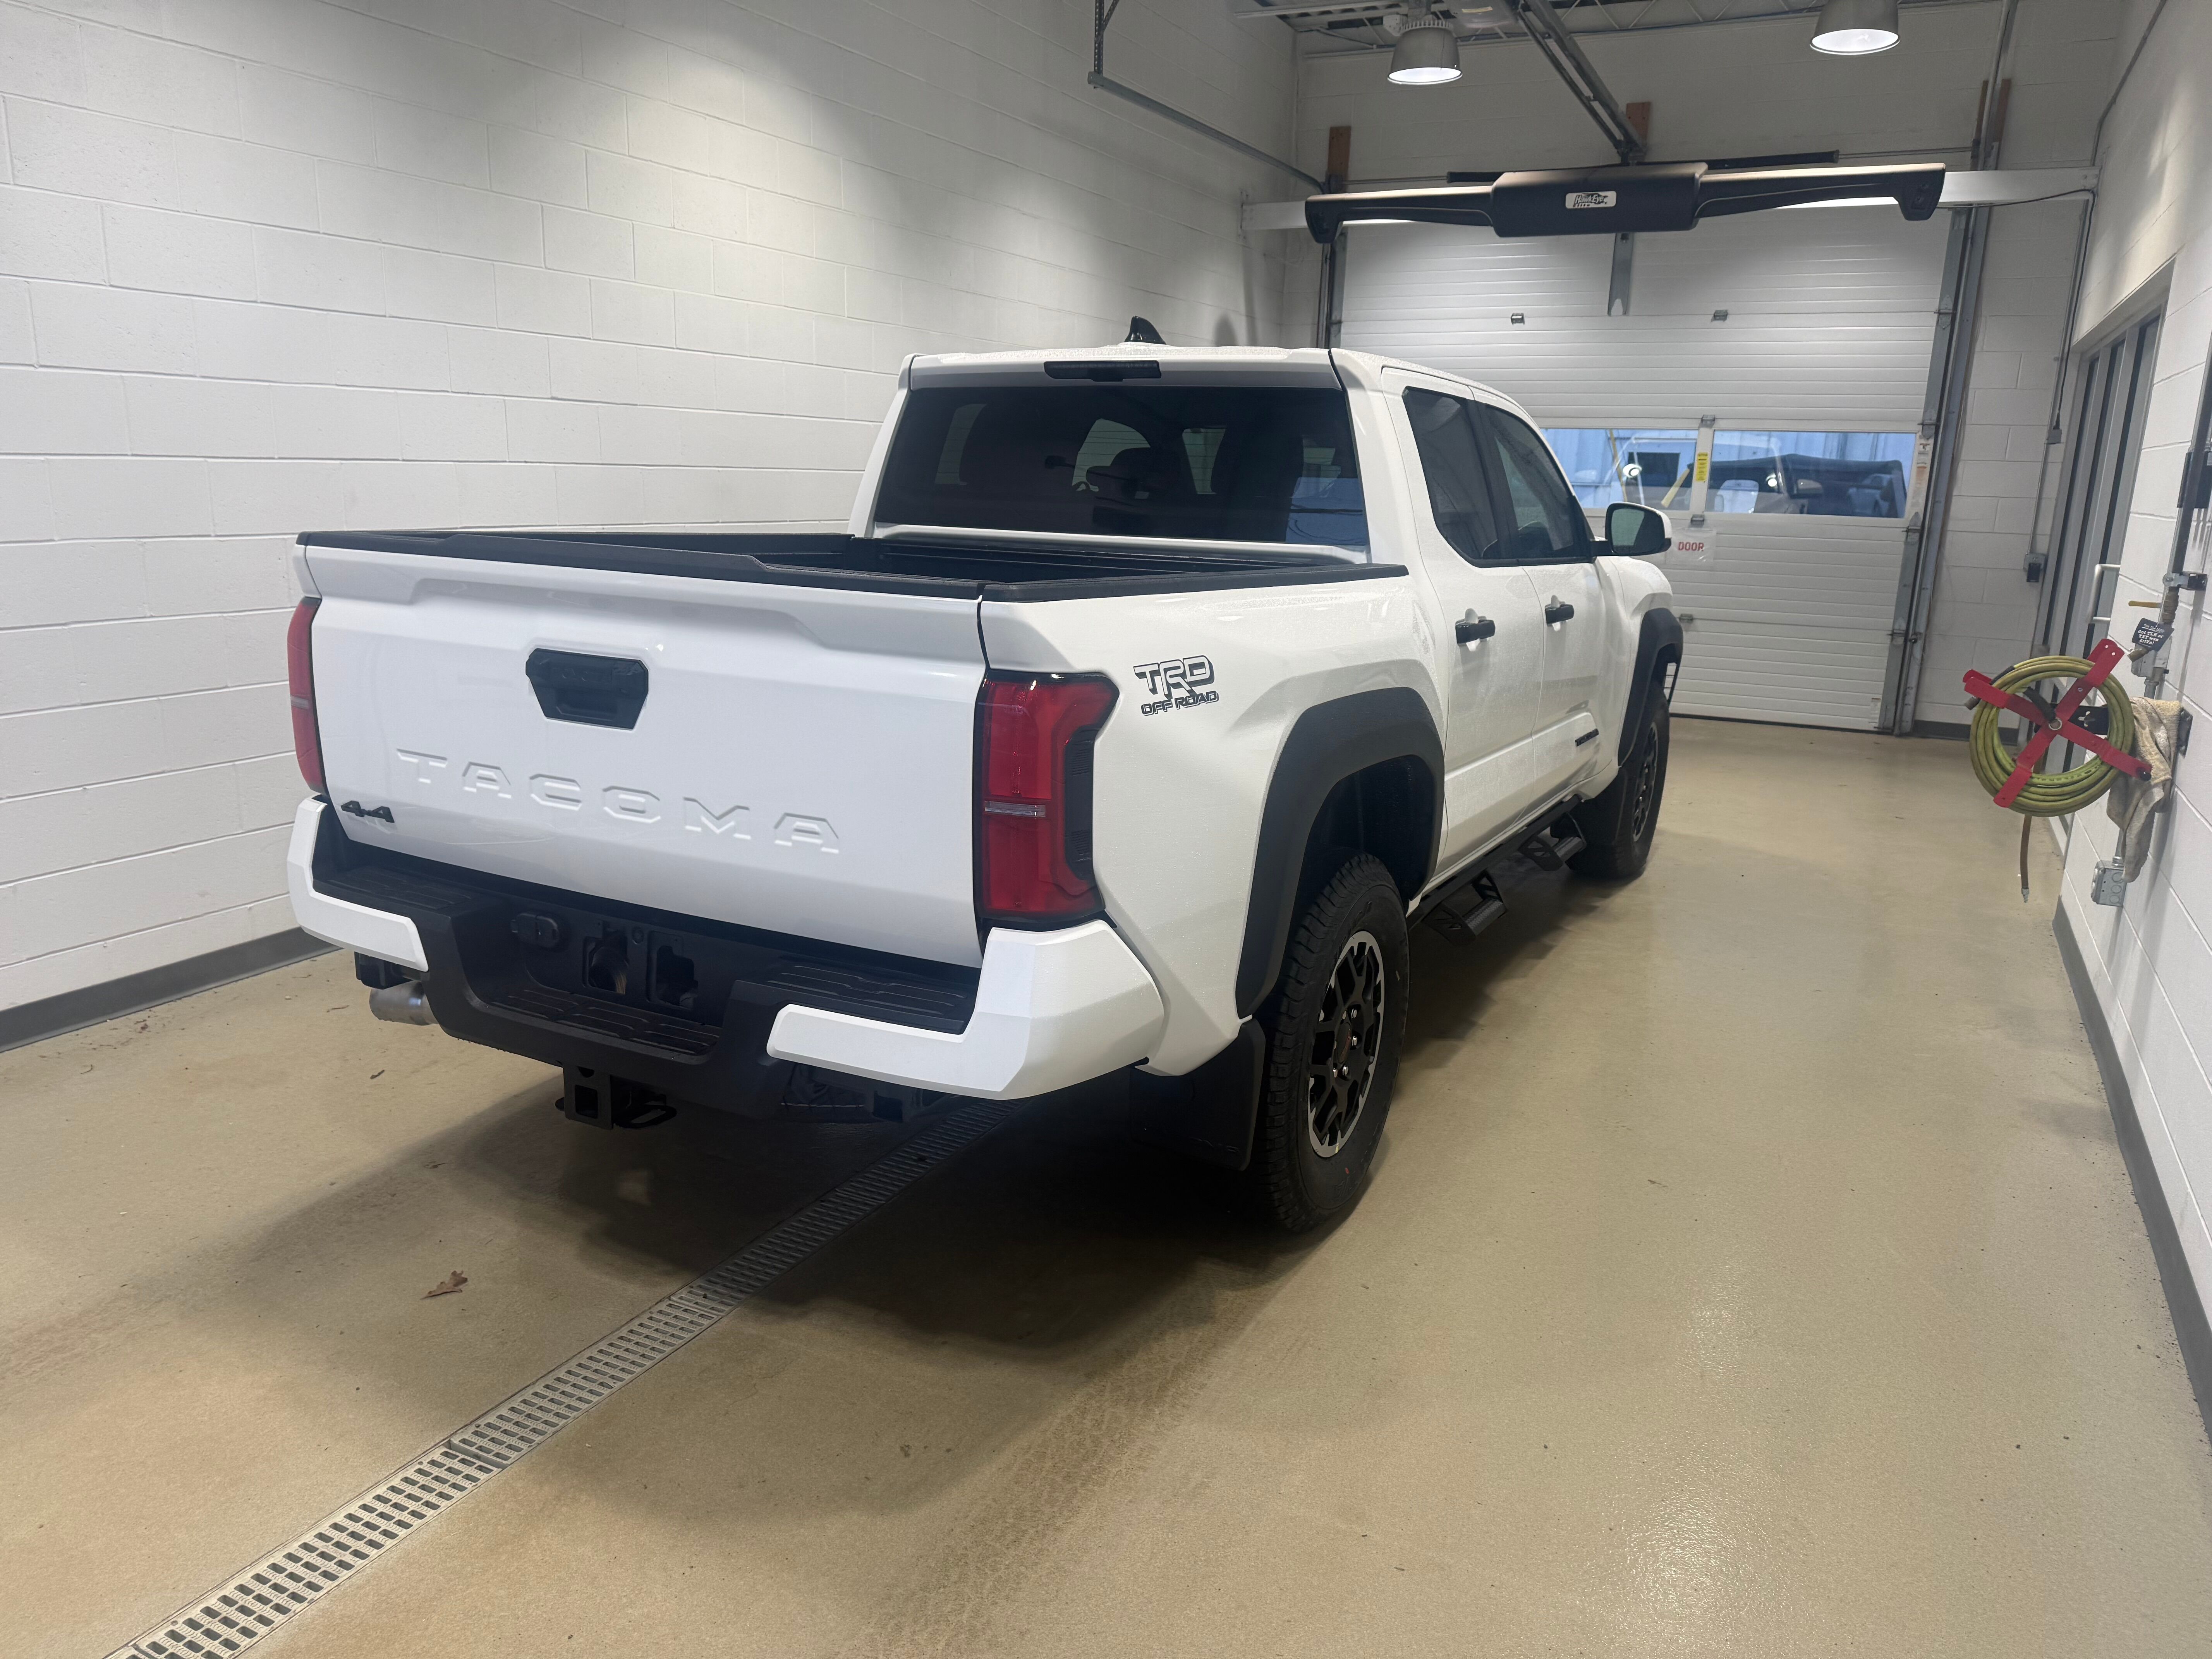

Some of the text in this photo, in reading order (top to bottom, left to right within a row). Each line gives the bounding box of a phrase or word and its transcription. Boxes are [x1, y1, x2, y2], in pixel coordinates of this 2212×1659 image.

[1574, 194, 1604, 204] HawkEye
[1678, 541, 1704, 551] DOOR
[1133, 655, 1215, 701] TRD
[1141, 690, 1219, 716] OFF ROAD
[396, 748, 840, 854] TACOMA
